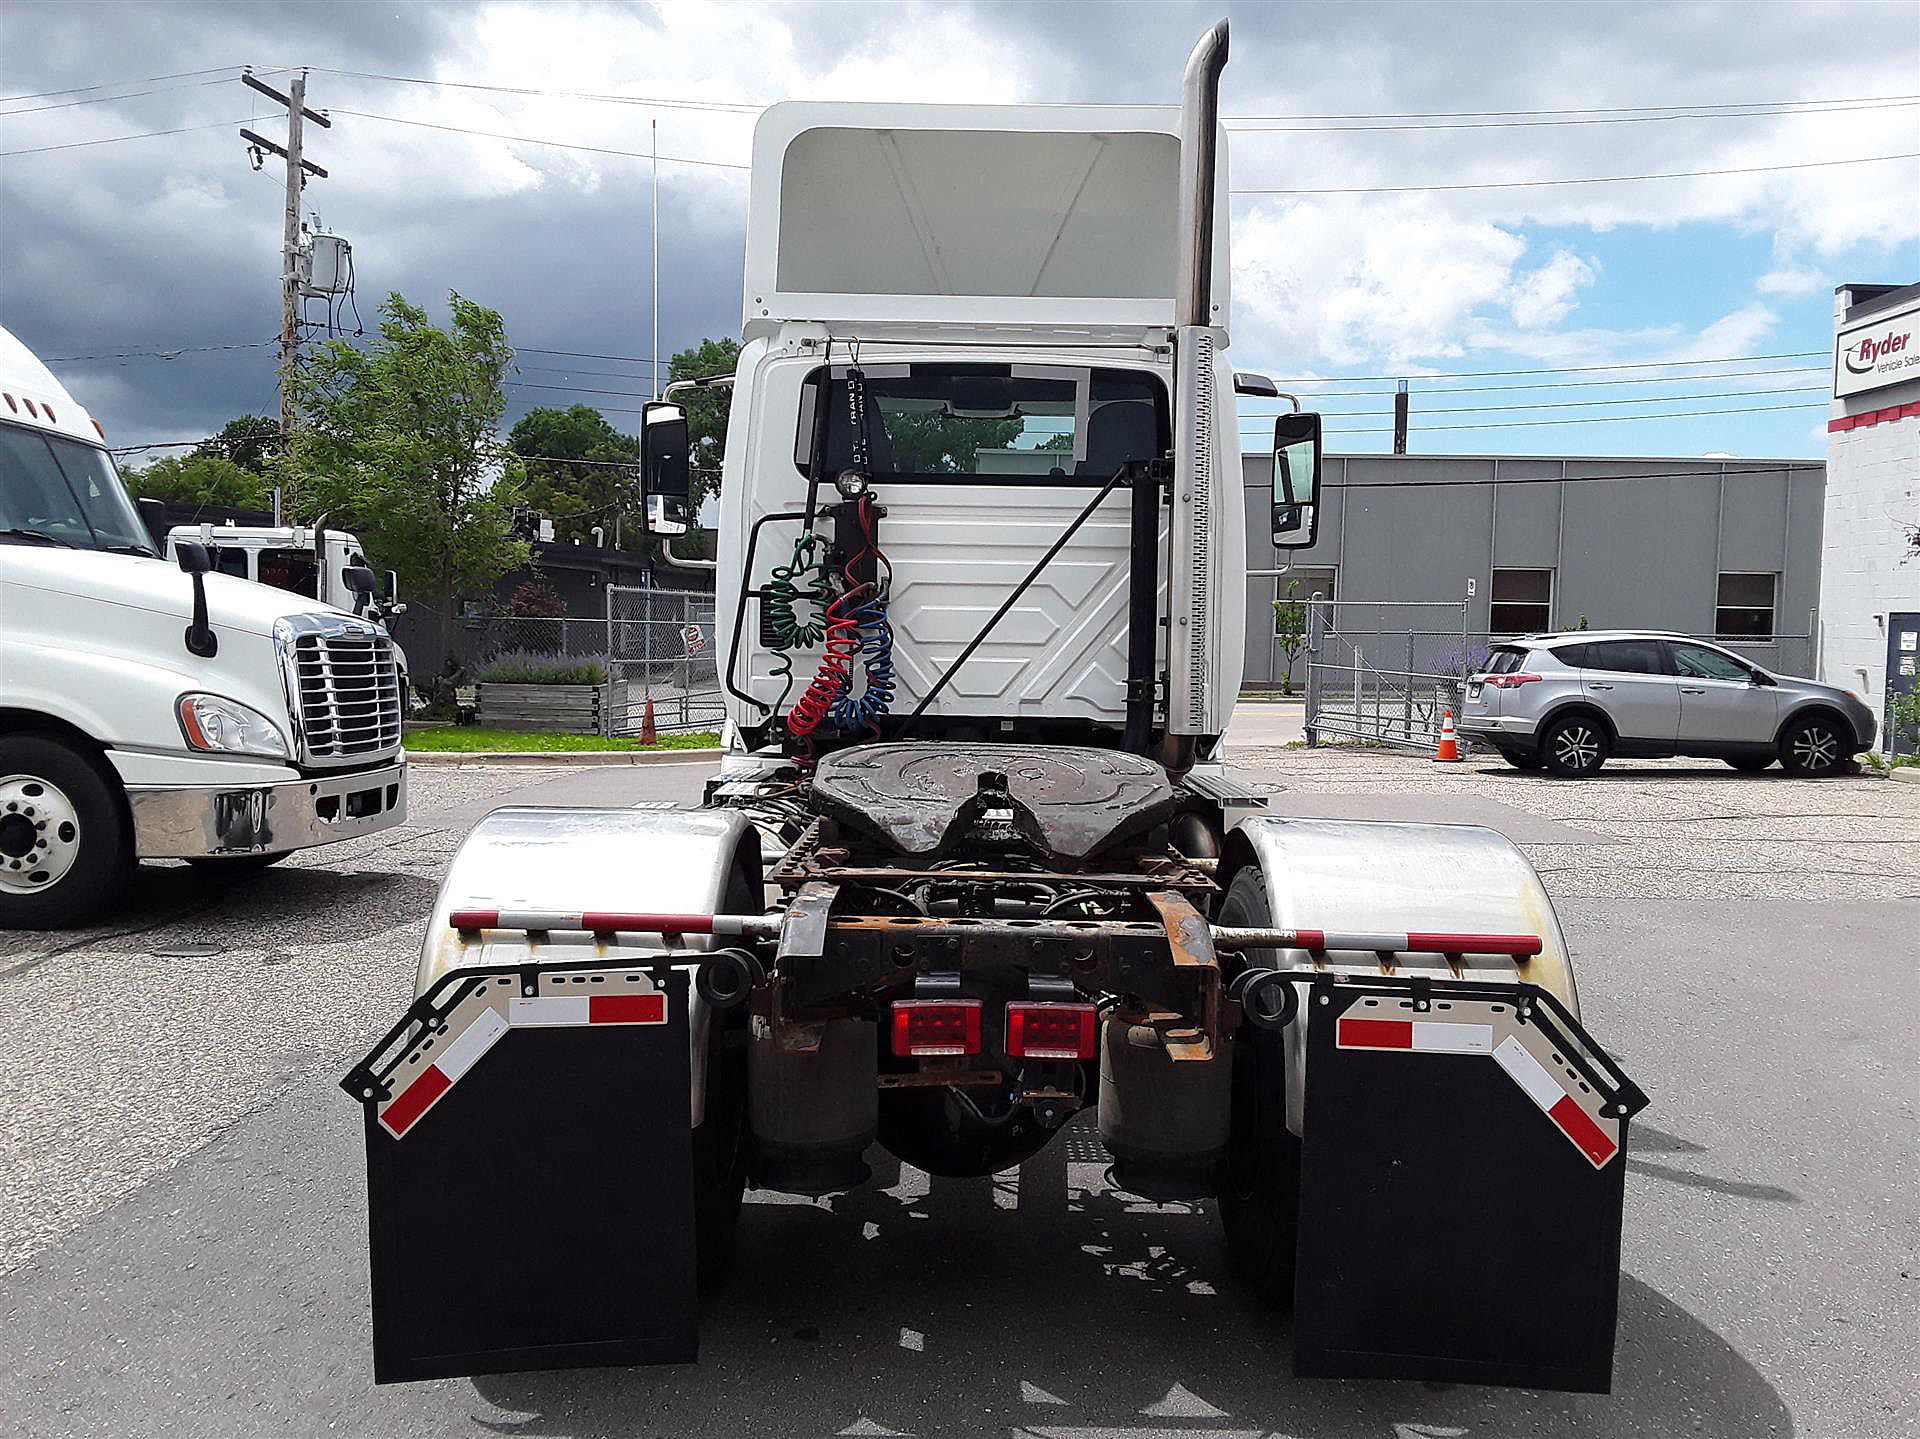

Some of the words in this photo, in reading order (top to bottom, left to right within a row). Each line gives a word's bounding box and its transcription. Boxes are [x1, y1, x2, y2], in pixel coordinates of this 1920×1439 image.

[1859, 332, 1911, 364] Ryder
[1877, 358, 1903, 374] Vehicle
[1904, 354, 1920, 367] Sale
